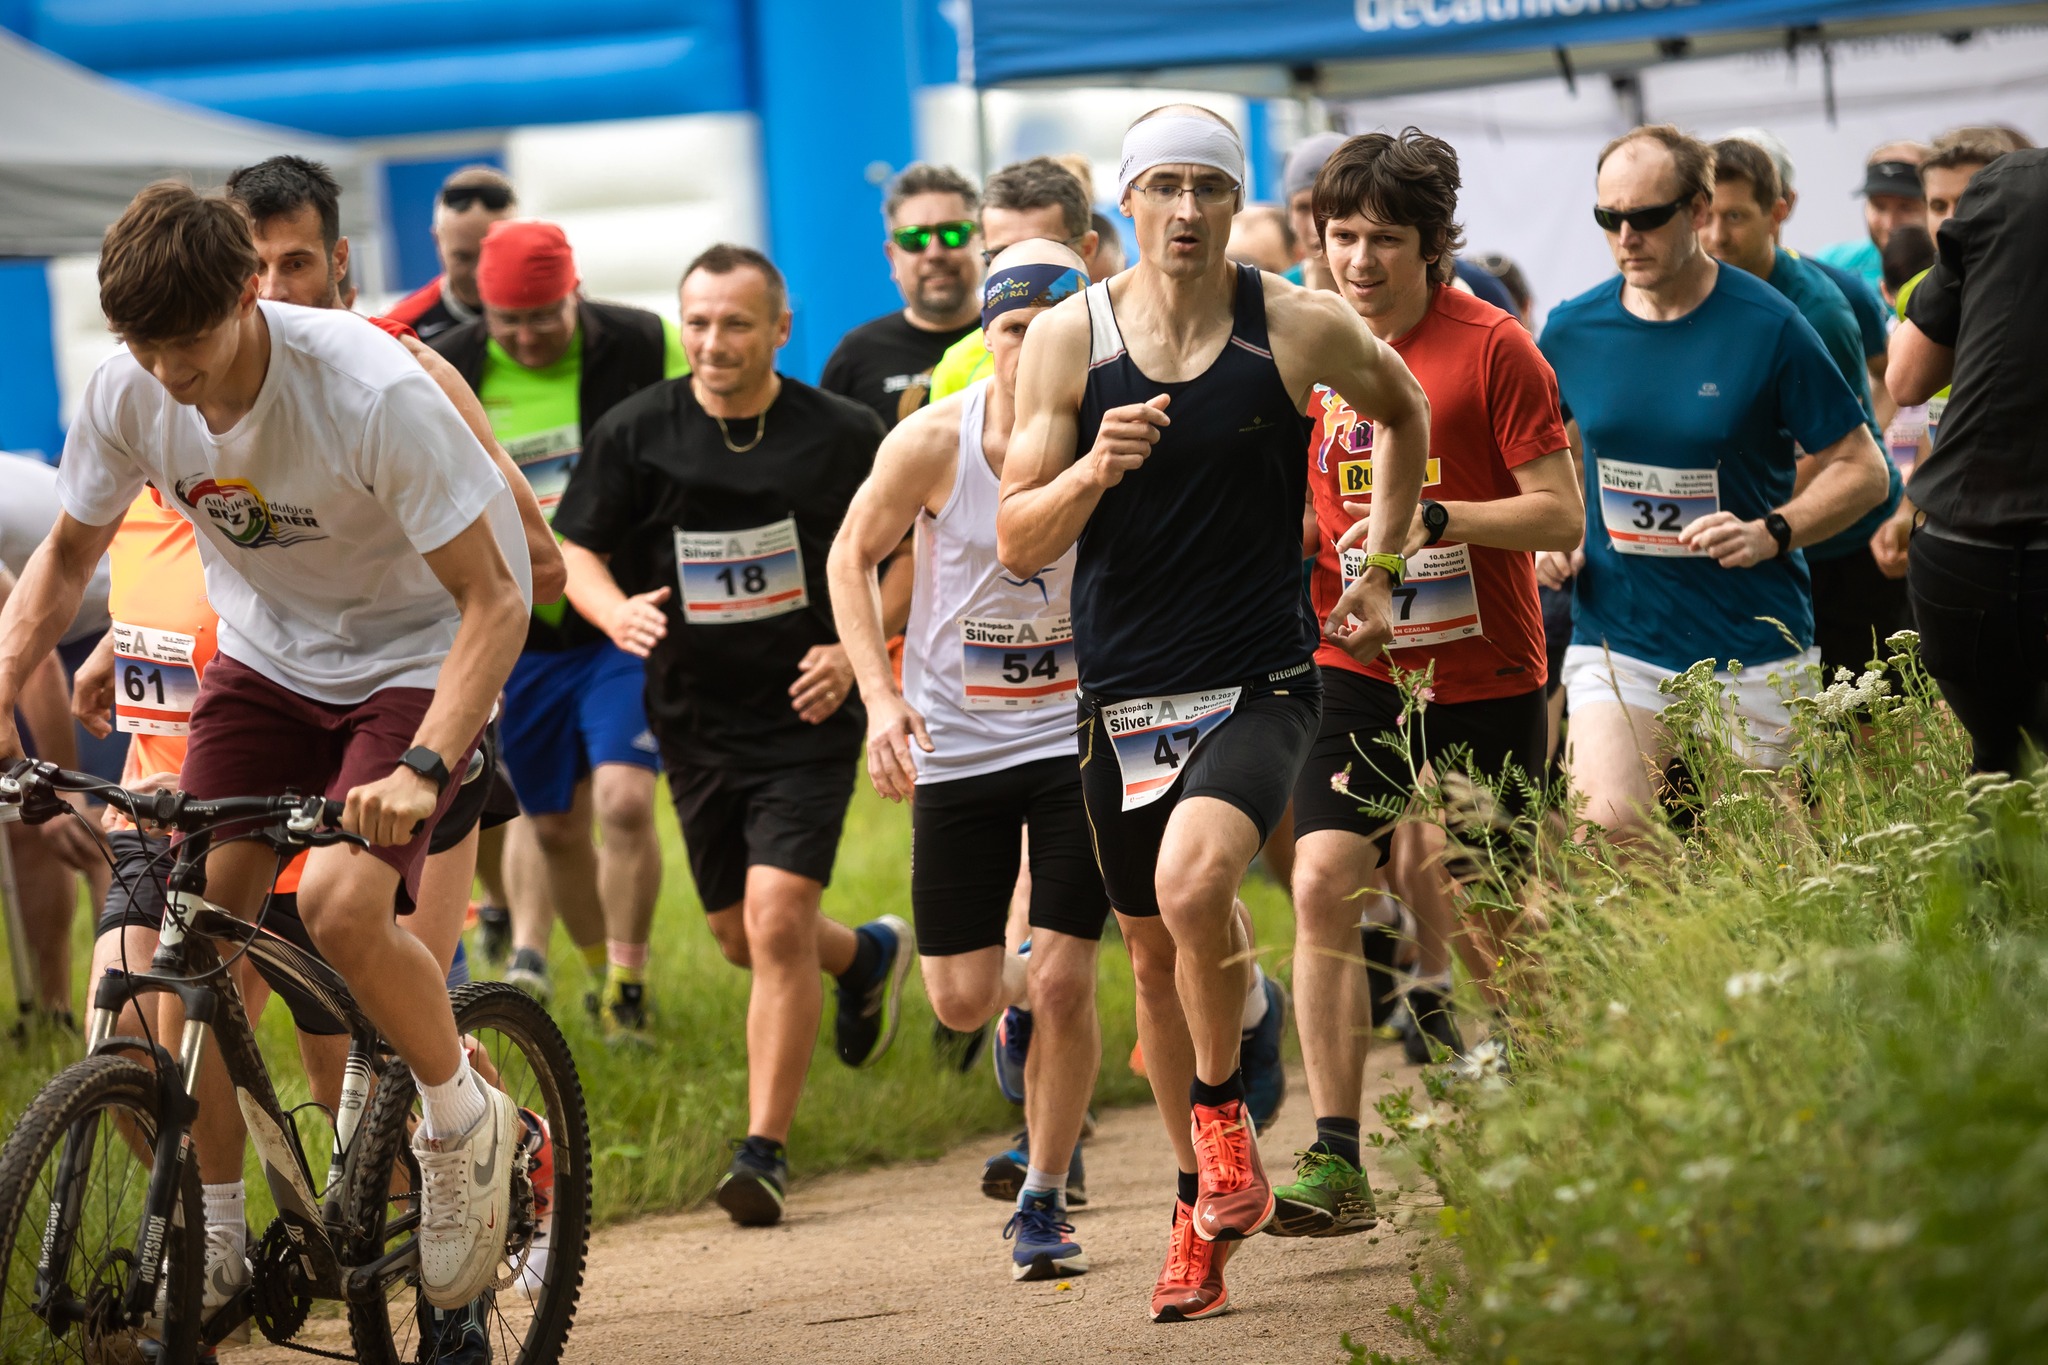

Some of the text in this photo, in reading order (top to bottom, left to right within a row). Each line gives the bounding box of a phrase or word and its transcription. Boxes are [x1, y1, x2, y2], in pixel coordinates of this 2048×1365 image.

[1354, 0, 1702, 33] decatho.
[1604, 472, 1663, 492] Silver A
[248, 506, 320, 528] BRIER
[1632, 500, 1683, 531] 32
[1423, 558, 1465, 569] Dobročinný
[1429, 550, 1464, 560] 10.6.2023
[716, 565, 767, 596] 18
[1345, 564, 1360, 577] Sil
[1440, 565, 1467, 576] pochod
[966, 623, 1039, 644] Silver A
[978, 622, 1014, 630] stopách
[115, 631, 149, 657] ver A
[1002, 649, 1059, 684] 54
[124, 664, 165, 705] 61
[1105, 702, 1153, 718] Po stopách
[1110, 700, 1178, 732] Silver A
[1153, 726, 1200, 769] 47
[139, 1215, 167, 1284] ROCKSHOX
